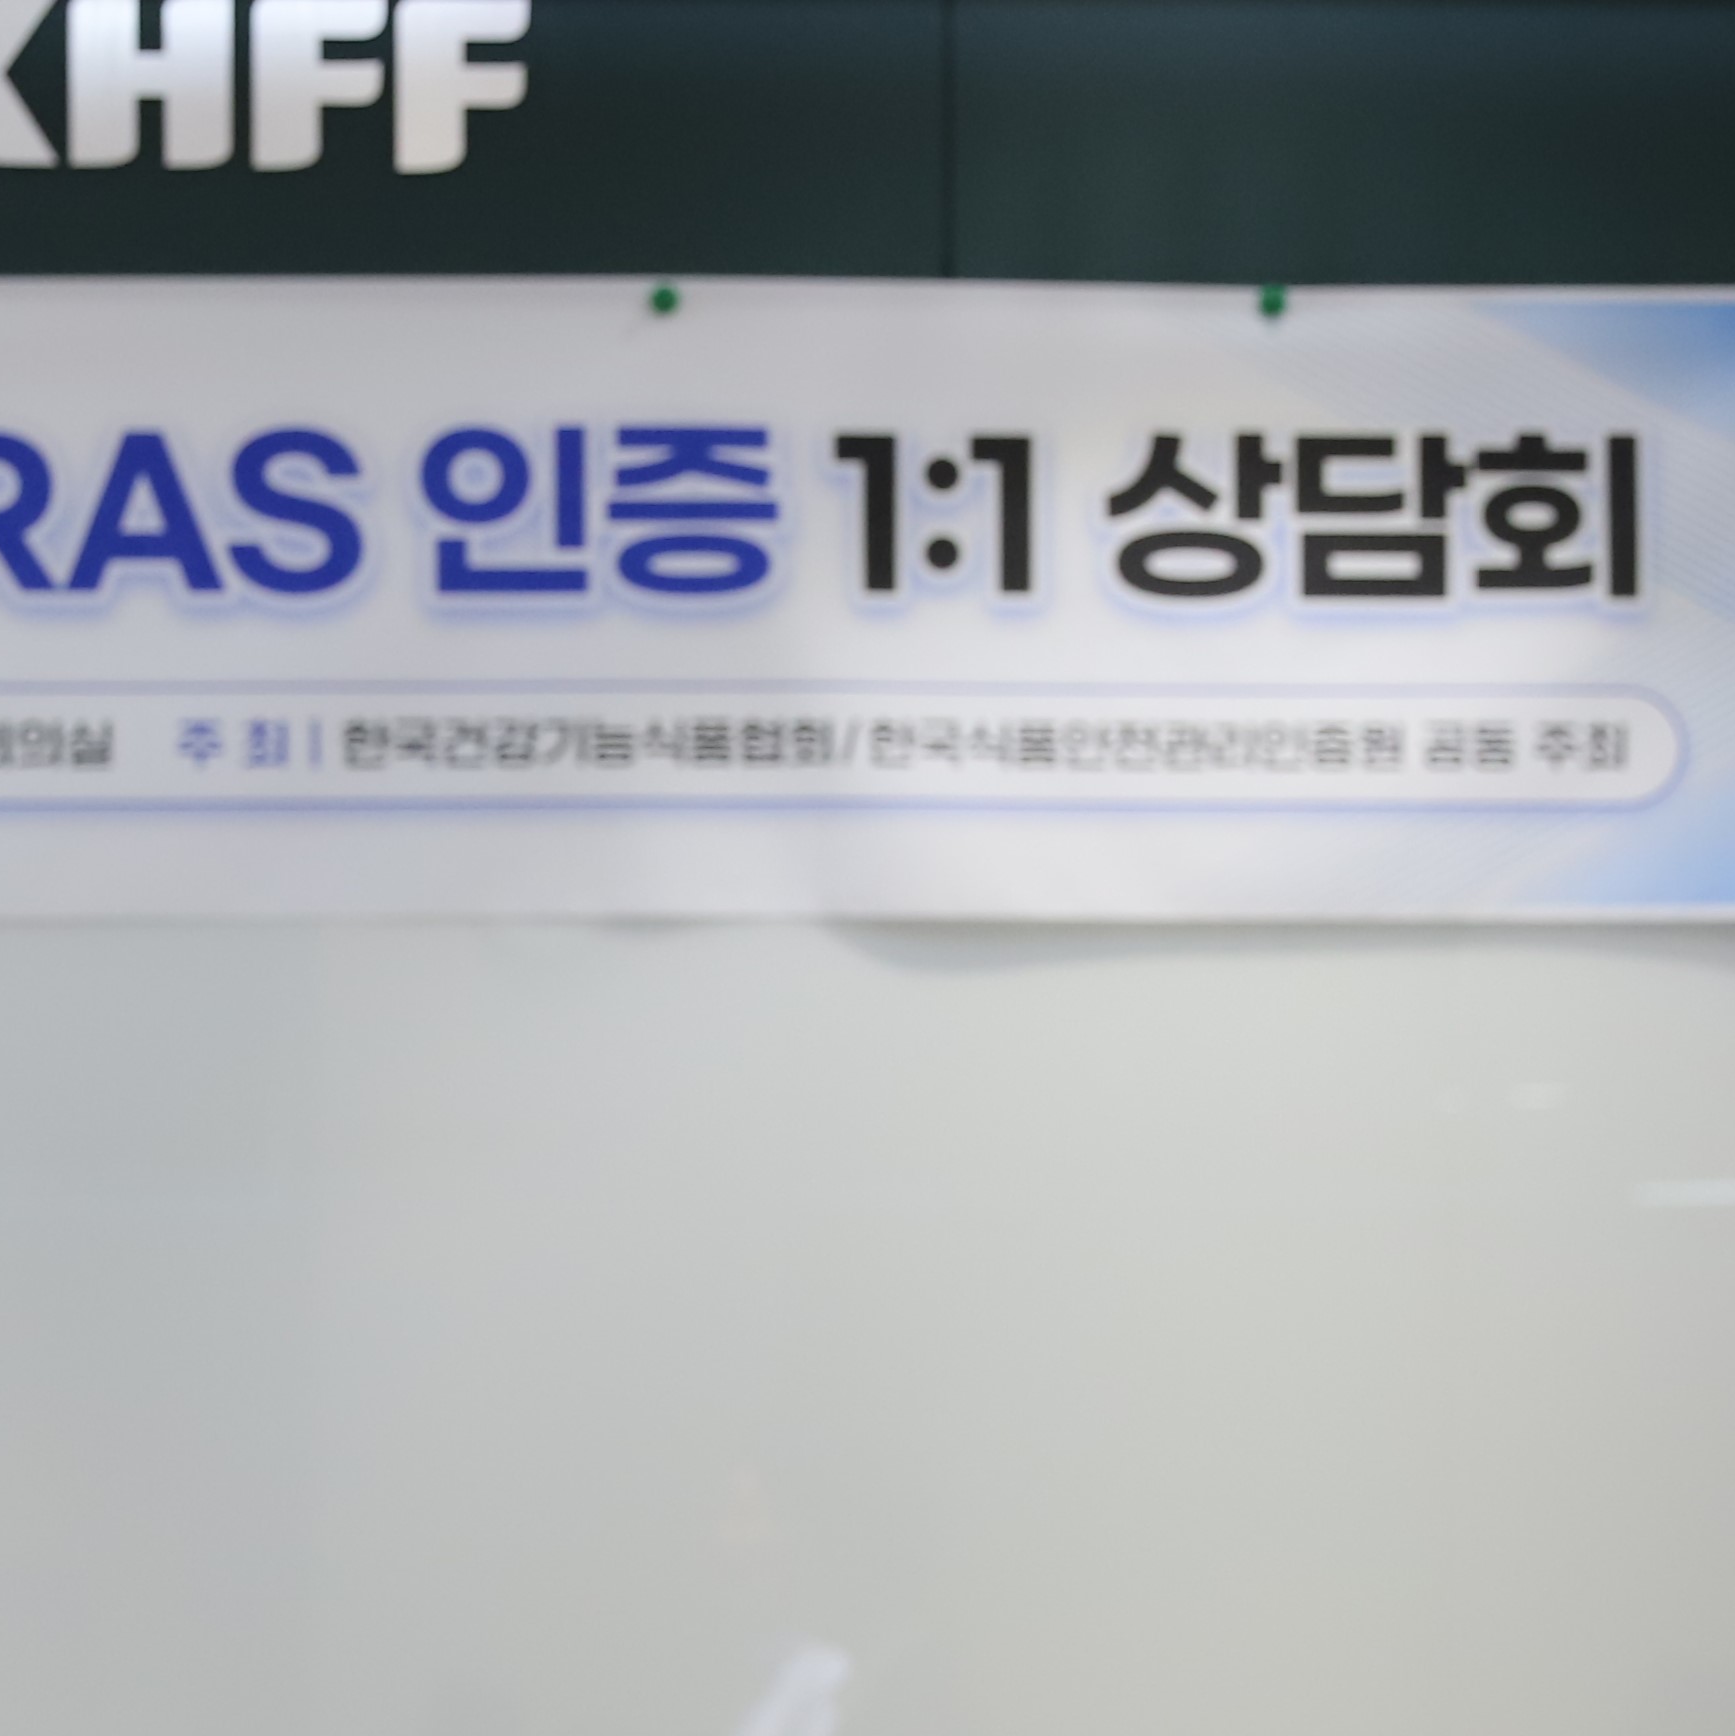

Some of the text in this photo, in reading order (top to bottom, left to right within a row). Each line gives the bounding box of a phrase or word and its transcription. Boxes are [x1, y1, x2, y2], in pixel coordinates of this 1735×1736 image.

[420, 427, 780, 596] 인증
[833, 432, 1034, 593] 1:1
[1106, 431, 1640, 599] 상담회
